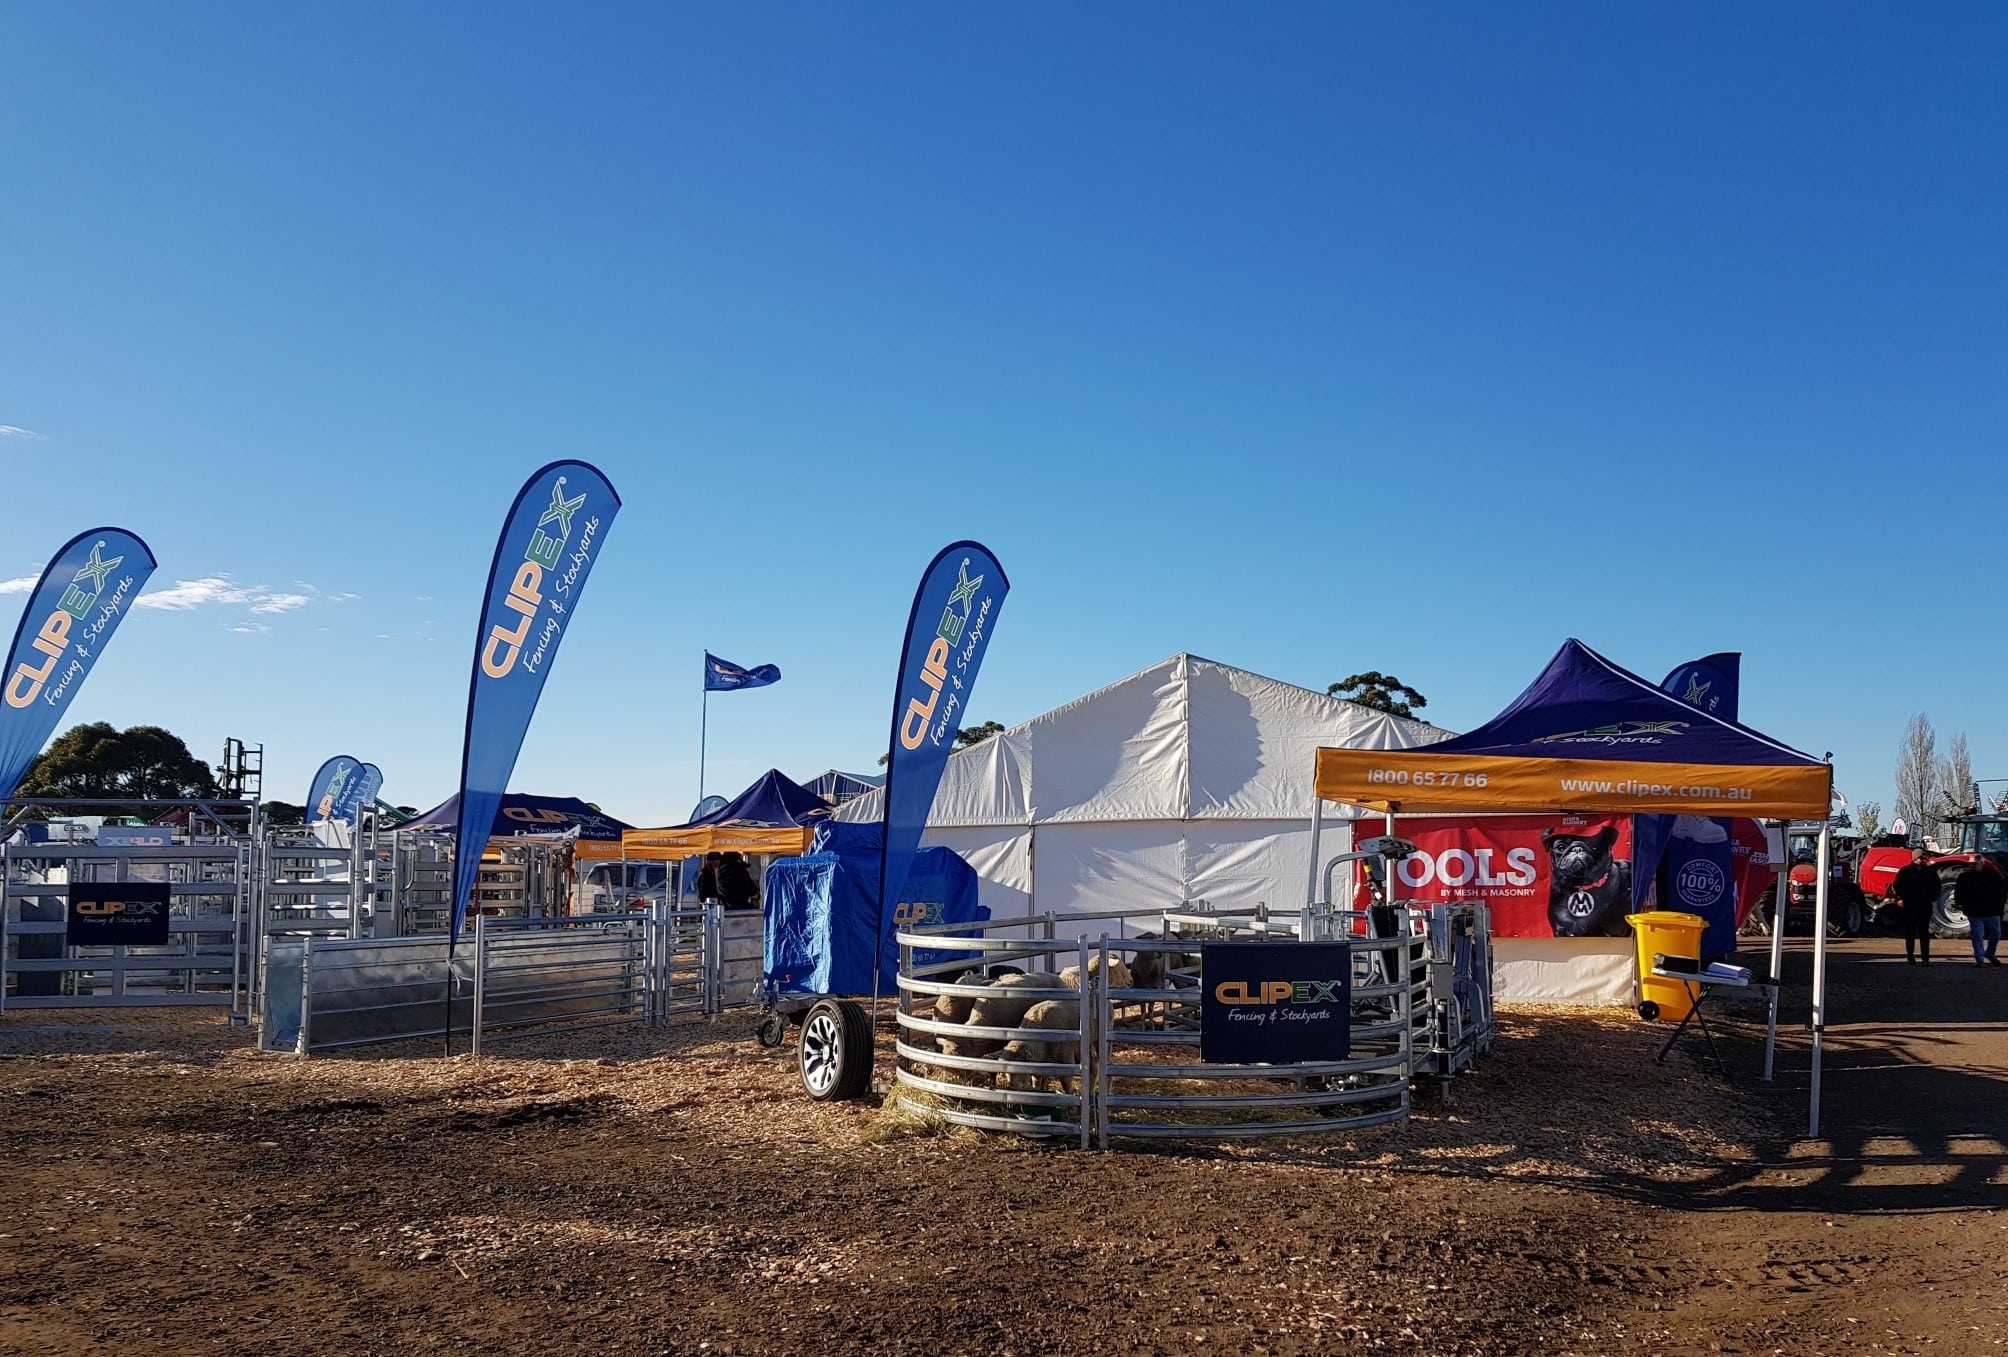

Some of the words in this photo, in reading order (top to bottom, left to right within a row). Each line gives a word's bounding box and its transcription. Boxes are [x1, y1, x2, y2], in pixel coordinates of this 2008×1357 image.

[556, 515, 600, 599] Stockyards
[481, 476, 587, 678] CLIPEX
[83, 574, 134, 646] Stockyards
[549, 598, 566, 614] &
[5, 540, 124, 708] CLIPEX
[957, 595, 993, 676] Stockyards
[75, 643, 92, 658] &
[523, 617, 560, 674] Fencing
[900, 557, 984, 750] CLIPEX
[44, 658, 85, 707] Fencing
[952, 674, 964, 691] &
[930, 692, 960, 746] Fencing
[1367, 769, 1408, 785] 1800
[1413, 771, 1435, 786] 65
[1439, 772, 1460, 786] 77
[1463, 773, 1488, 788] 66
[1560, 778, 1753, 801] www.clipex.com.au
[1378, 847, 1537, 887] OOLS
[1687, 862, 1720, 876] COMFORT
[1440, 889, 1451, 897] BY
[1453, 888, 1478, 897] MESH
[1480, 889, 1488, 897] &
[1489, 888, 1536, 897] MASONRY
[1681, 873, 1721, 892] 100%
[76, 901, 162, 915] CLIPEX
[1215, 980, 1341, 1004] CLIPEX
[1228, 1008, 1266, 1026] Fencing
[1269, 1008, 1277, 1023] &
[1280, 1007, 1331, 1024] Stockyards
